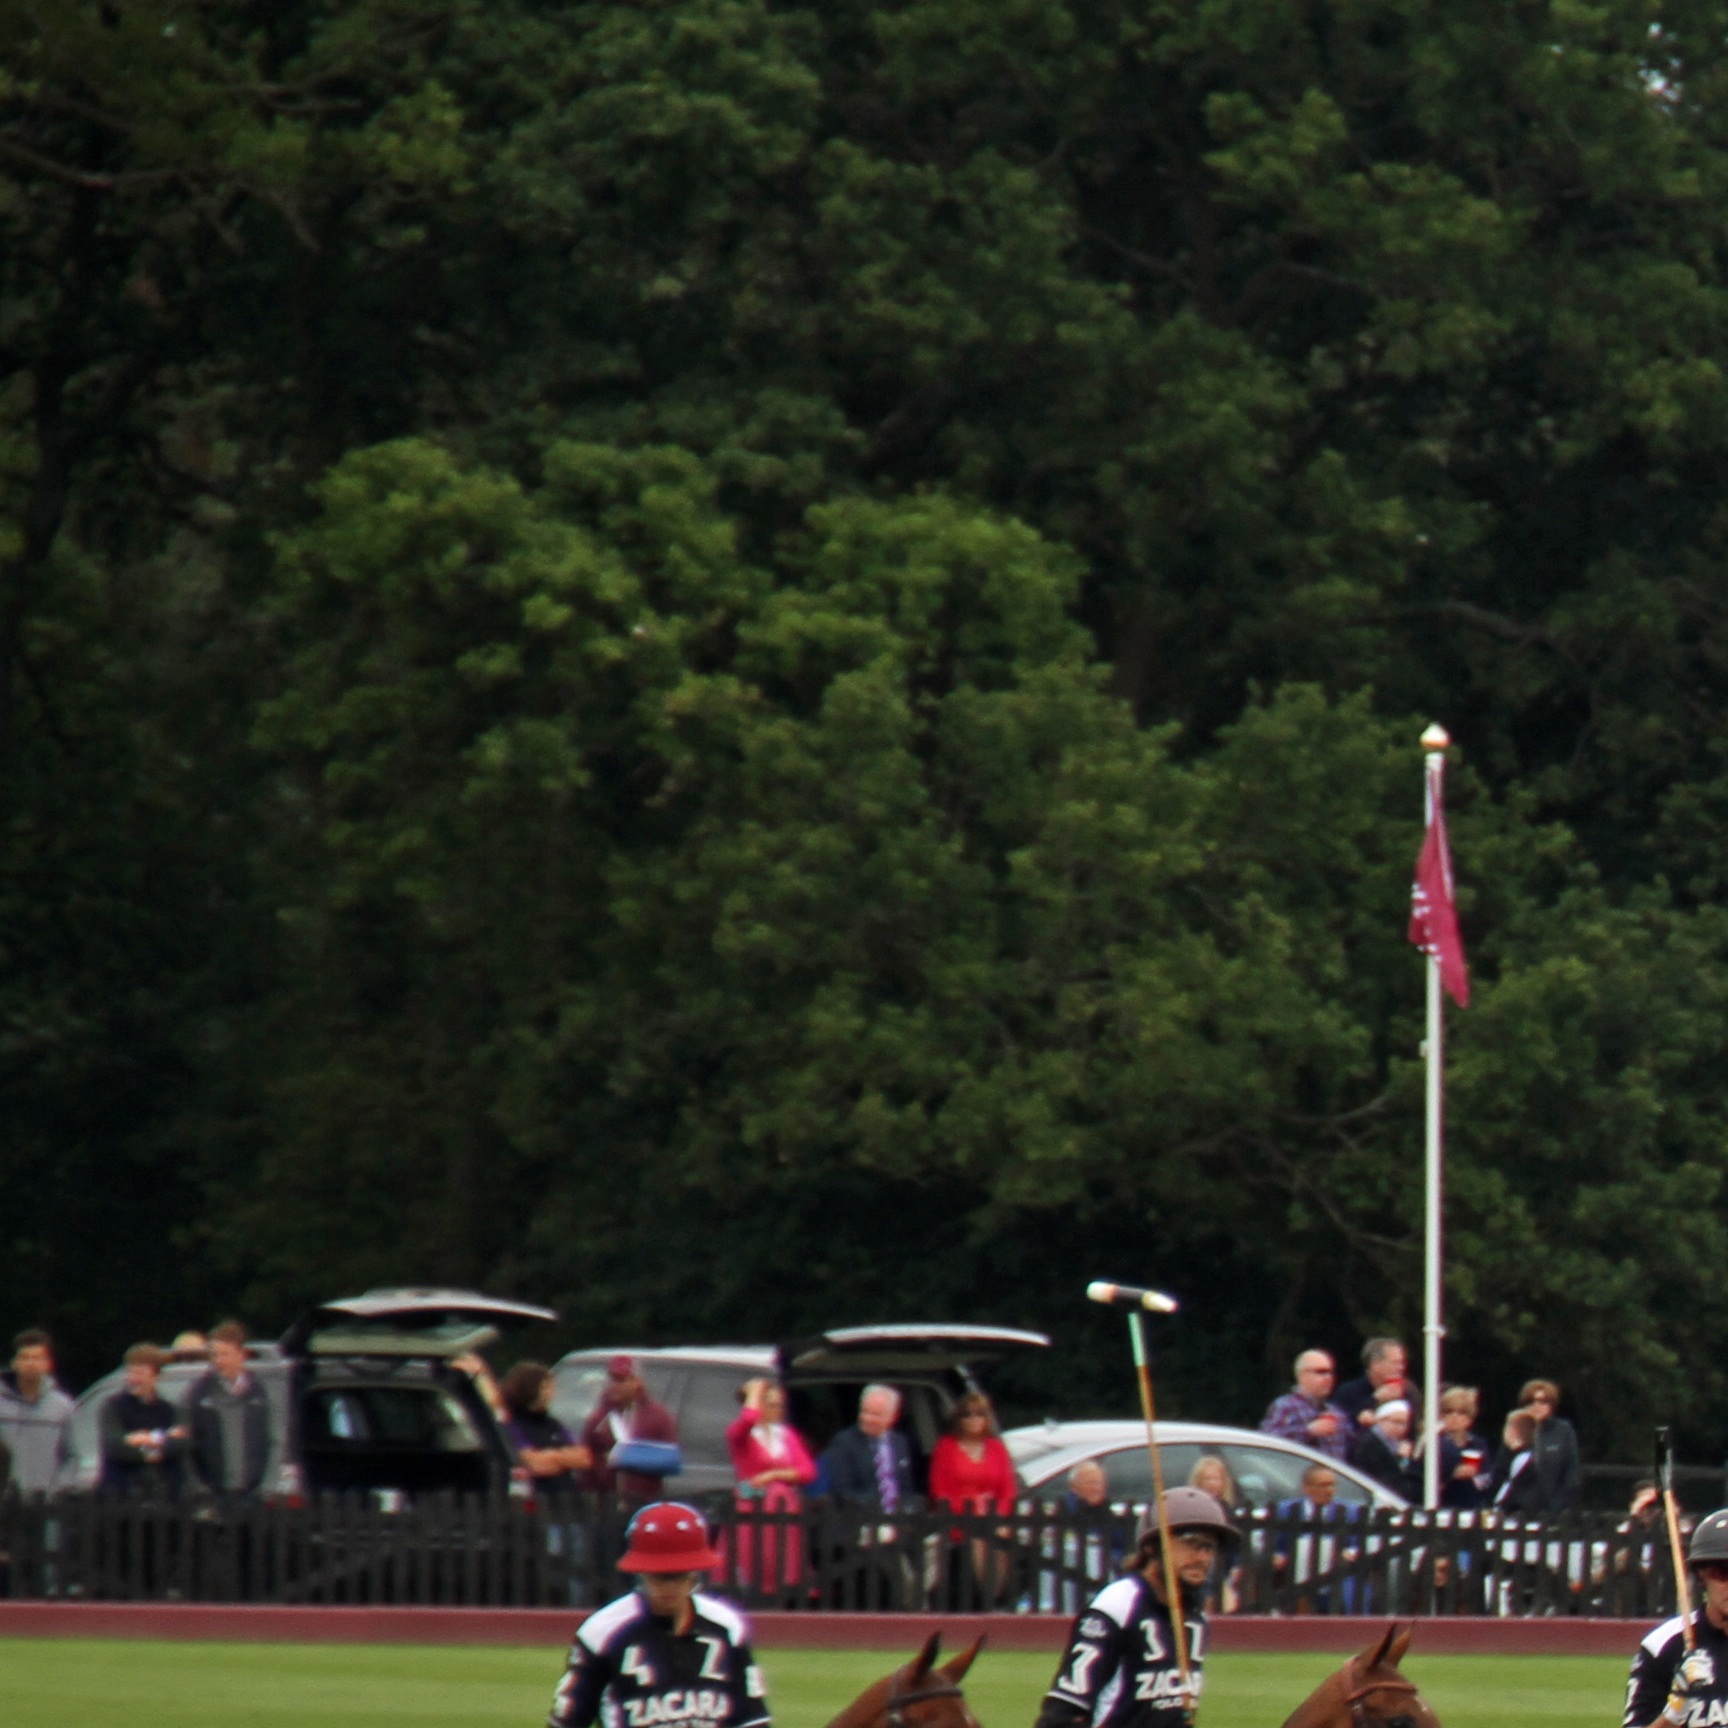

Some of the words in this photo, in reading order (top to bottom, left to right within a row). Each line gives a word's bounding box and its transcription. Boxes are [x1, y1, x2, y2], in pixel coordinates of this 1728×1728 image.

[695, 1635, 730, 1682] Z
[1057, 1642, 1102, 1696] 3
[1135, 1668, 1204, 1701] ZACAR
